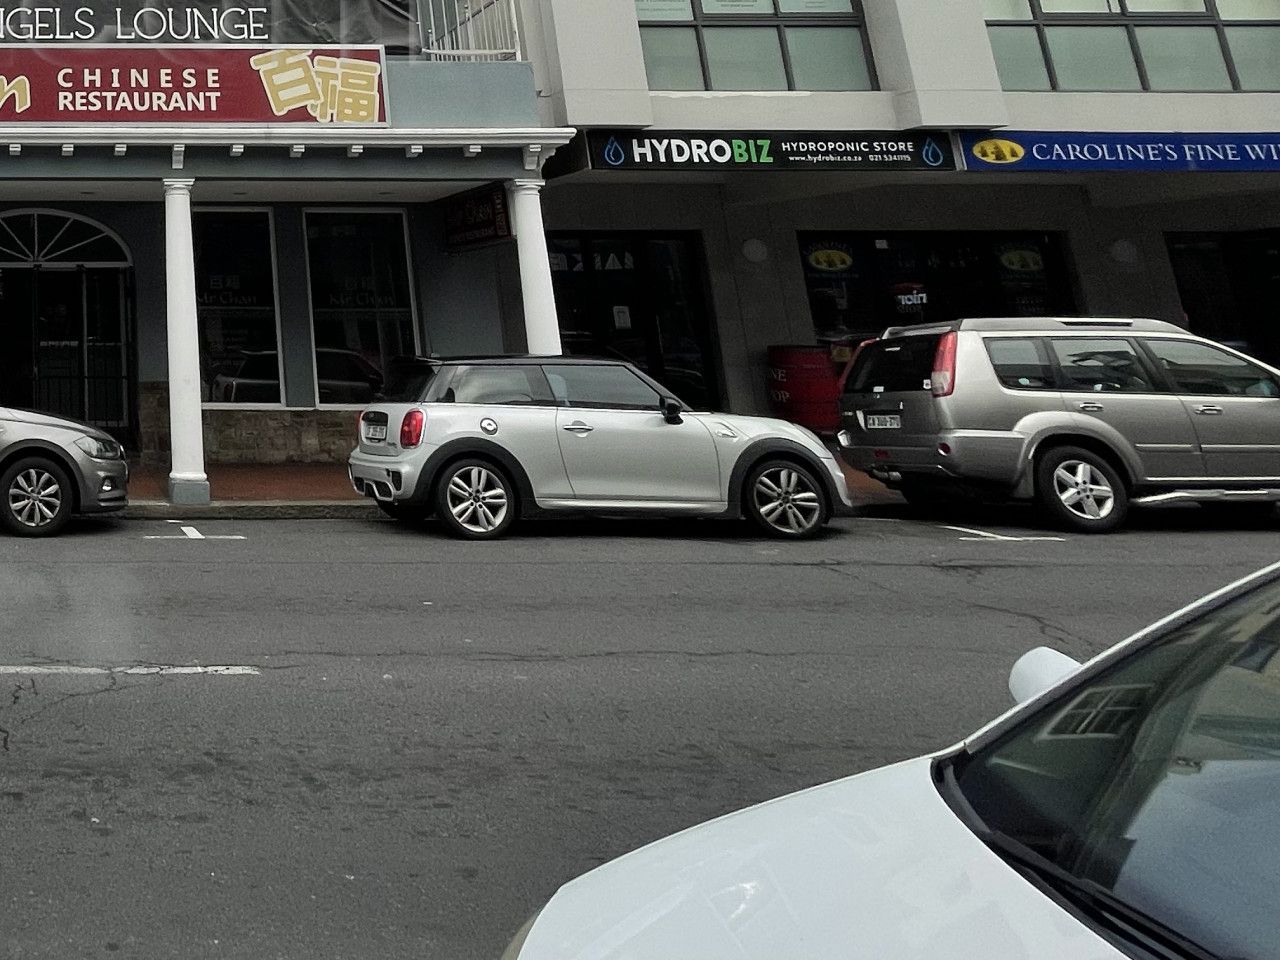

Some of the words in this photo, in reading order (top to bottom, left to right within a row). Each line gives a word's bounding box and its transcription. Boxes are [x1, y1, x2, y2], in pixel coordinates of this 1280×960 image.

[115, 7, 270, 40] LOUNGE
[57, 68, 221, 88] CHINESE
[249, 48, 382, 124] 百福
[58, 91, 221, 112] RESTAURANT
[632, 138, 775, 164] HYDROBIZ
[781, 141, 870, 153] HYDROPONIC
[873, 140, 915, 152] STORE
[1032, 142, 1179, 161] CAROLINE'S
[1185, 144, 1240, 161] FINE
[1244, 144, 1280, 161] WI
